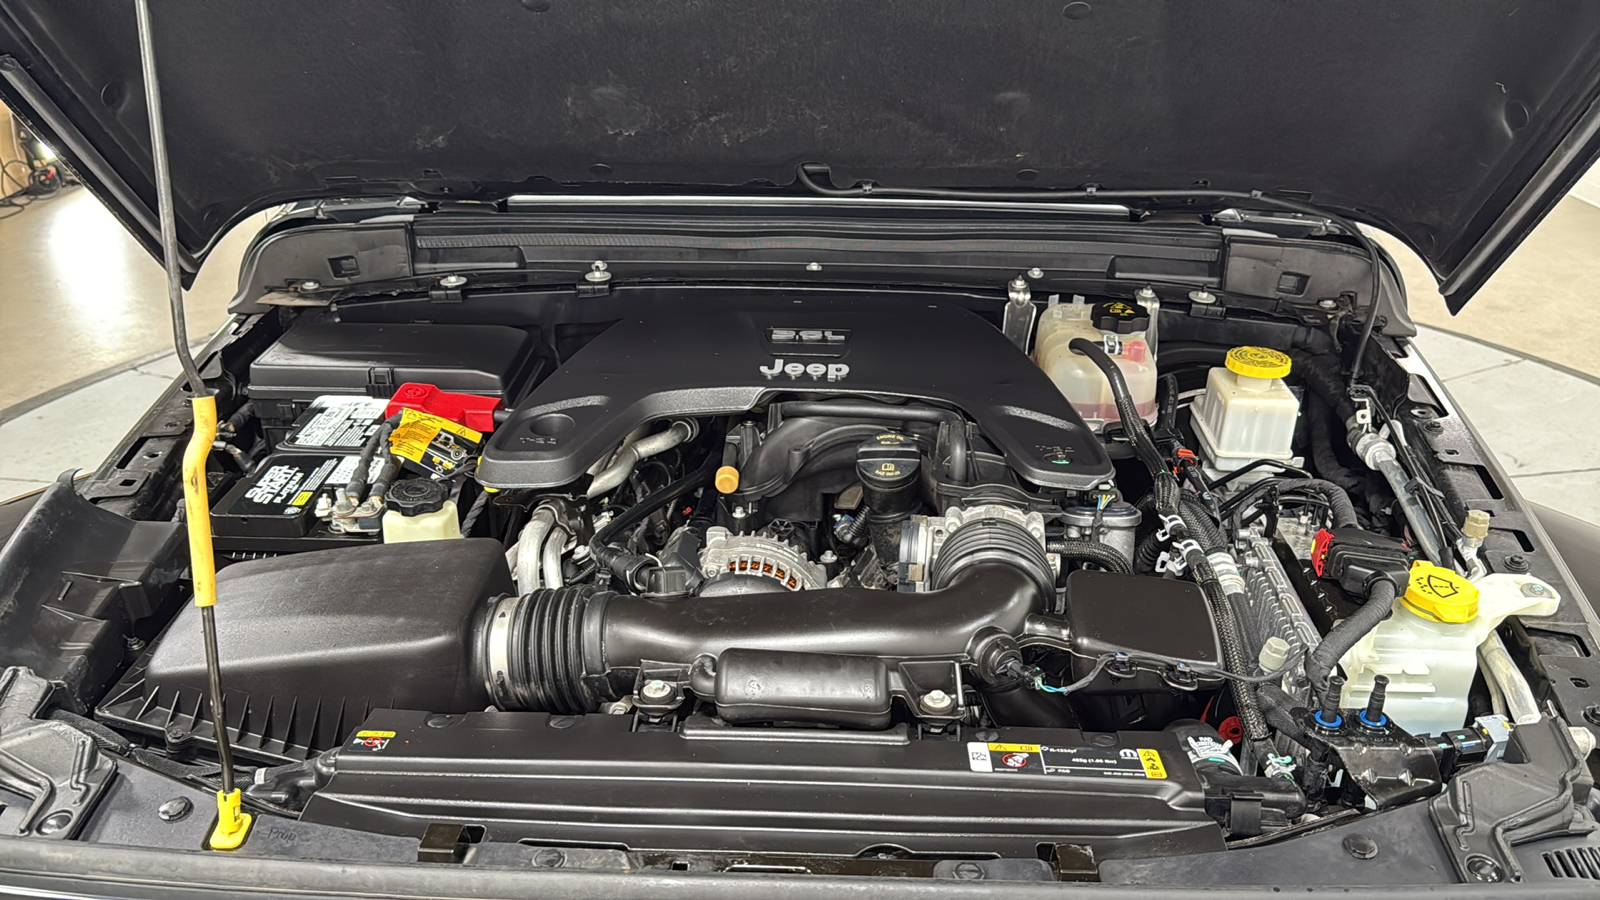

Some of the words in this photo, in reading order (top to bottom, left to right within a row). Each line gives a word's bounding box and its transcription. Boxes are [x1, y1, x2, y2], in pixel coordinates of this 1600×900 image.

[759, 359, 850, 382] Jeep
[245, 465, 289, 498] SUPER
[253, 465, 300, 505] START
